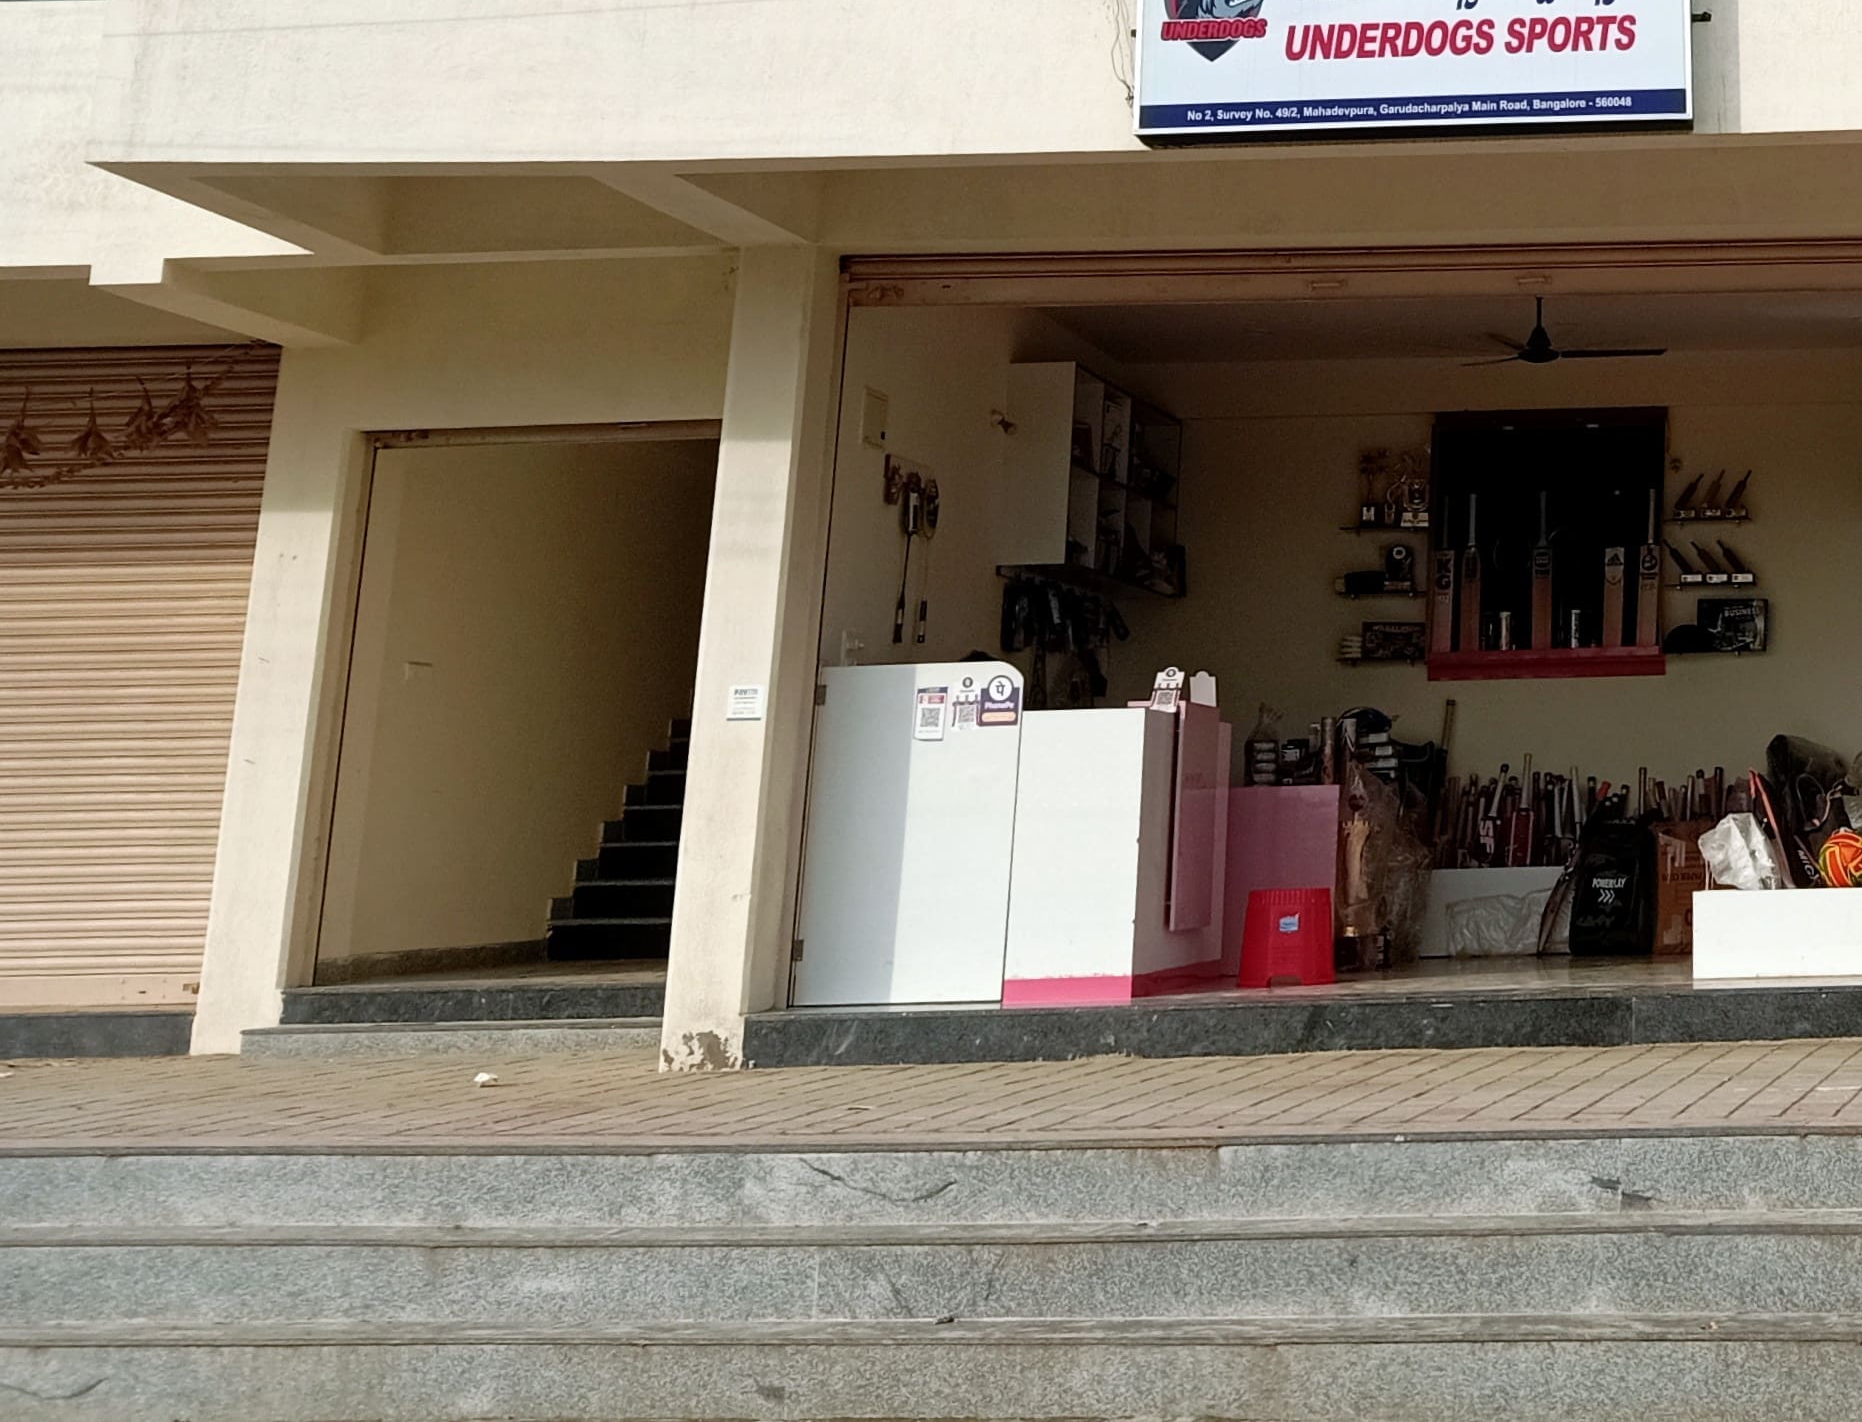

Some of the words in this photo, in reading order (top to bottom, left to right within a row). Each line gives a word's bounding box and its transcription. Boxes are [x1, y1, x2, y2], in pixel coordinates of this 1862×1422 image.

[1162, 19, 1267, 40] UNDERDOGS
[1285, 18, 1496, 61] UNDERDOGS
[1504, 14, 1637, 55] SPORTS
[1187, 110, 1202, 121] No
[1205, 109, 1214, 122] 2,
[1217, 109, 1253, 122] Survey
[1255, 108, 1273, 120] No.
[1275, 107, 1300, 120] 49/2,
[1303, 105, 1378, 118] Mahadevpura,
[1379, 102, 1470, 116] Garudacharpalya
[1472, 101, 1497, 111] Main
[1500, 100, 1530, 112] Road,
[1533, 98, 1586, 111] Bangalore
[1595, 96, 1632, 108] 560048
[995, 681, 1006, 697] पे
